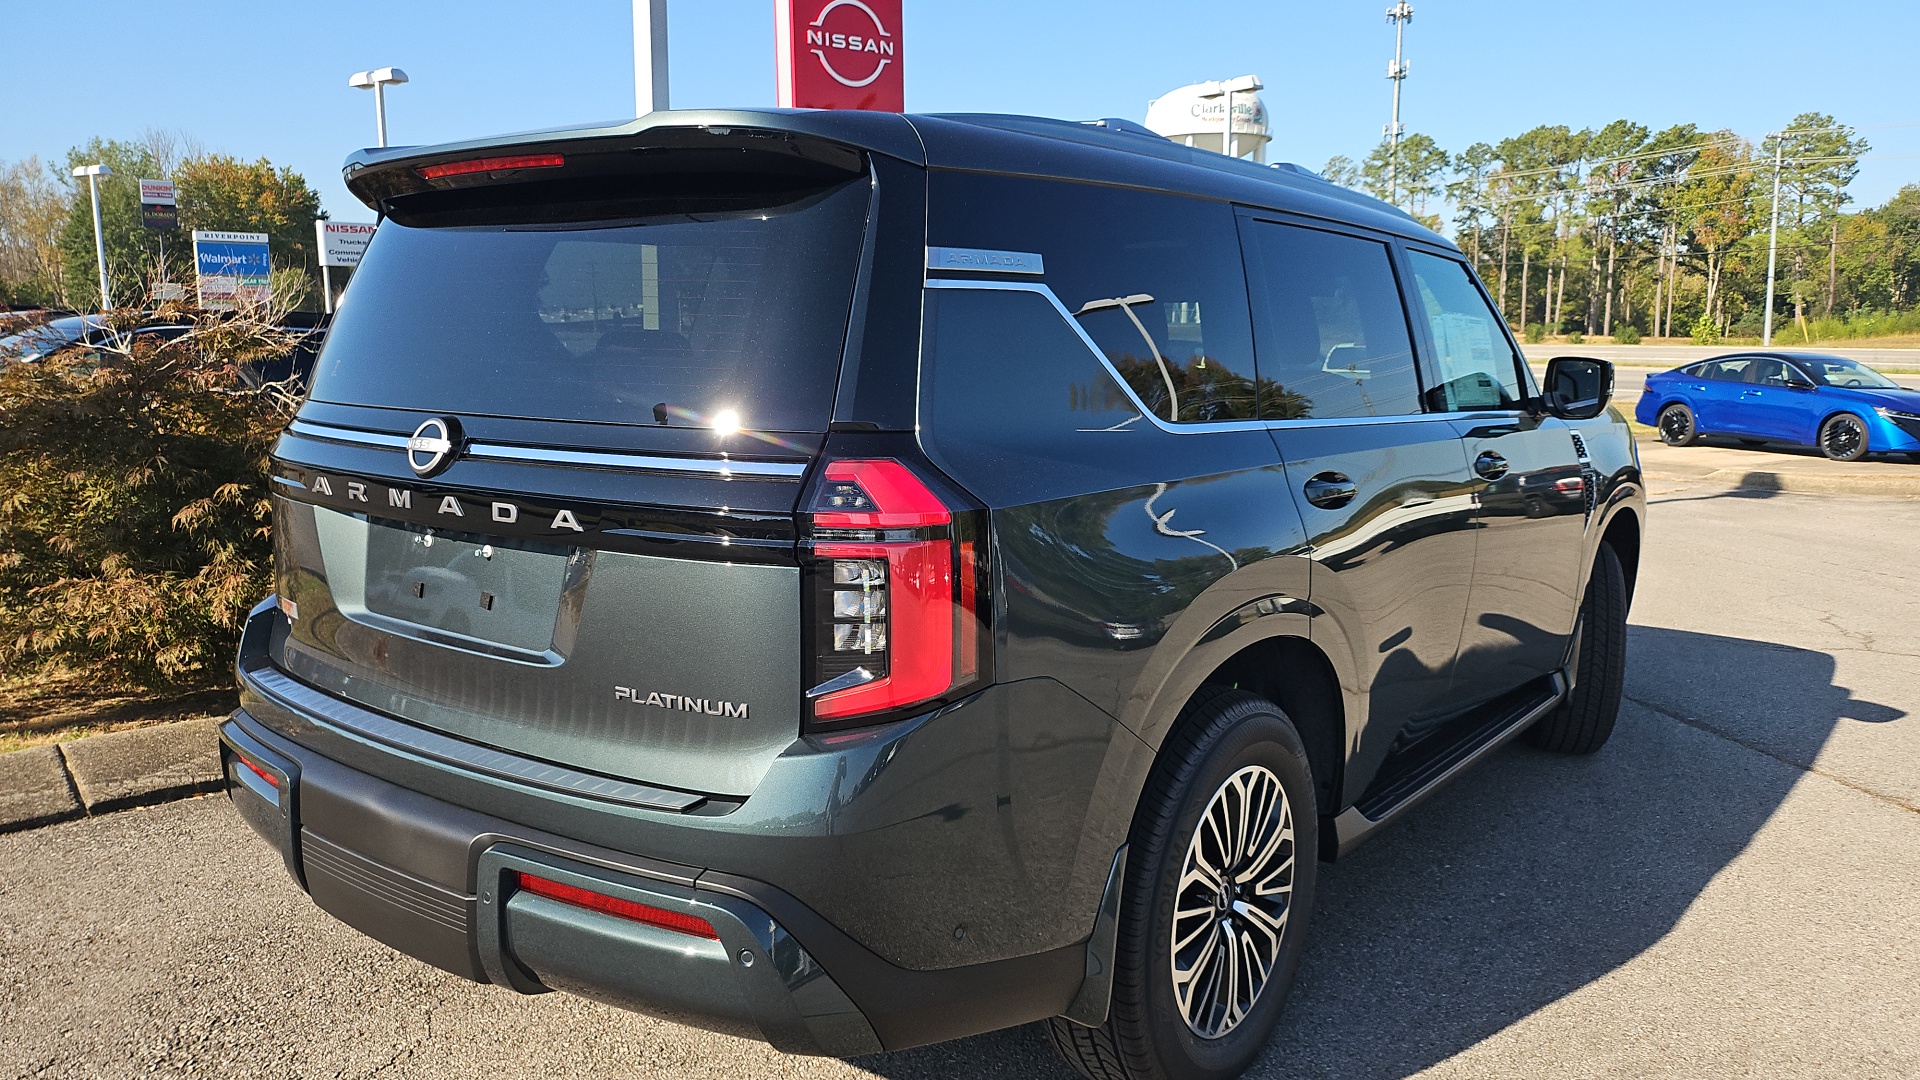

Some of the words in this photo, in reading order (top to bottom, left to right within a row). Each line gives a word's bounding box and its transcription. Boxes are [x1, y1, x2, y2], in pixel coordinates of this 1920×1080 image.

[807, 29, 894, 56] NISSAN
[1191, 103, 1252, 117] Clarkville
[200, 252, 247, 265] Walmart
[947, 253, 1027, 267] ARMADA
[311, 476, 585, 533] ARMADA
[614, 685, 750, 719] PLATINUM
